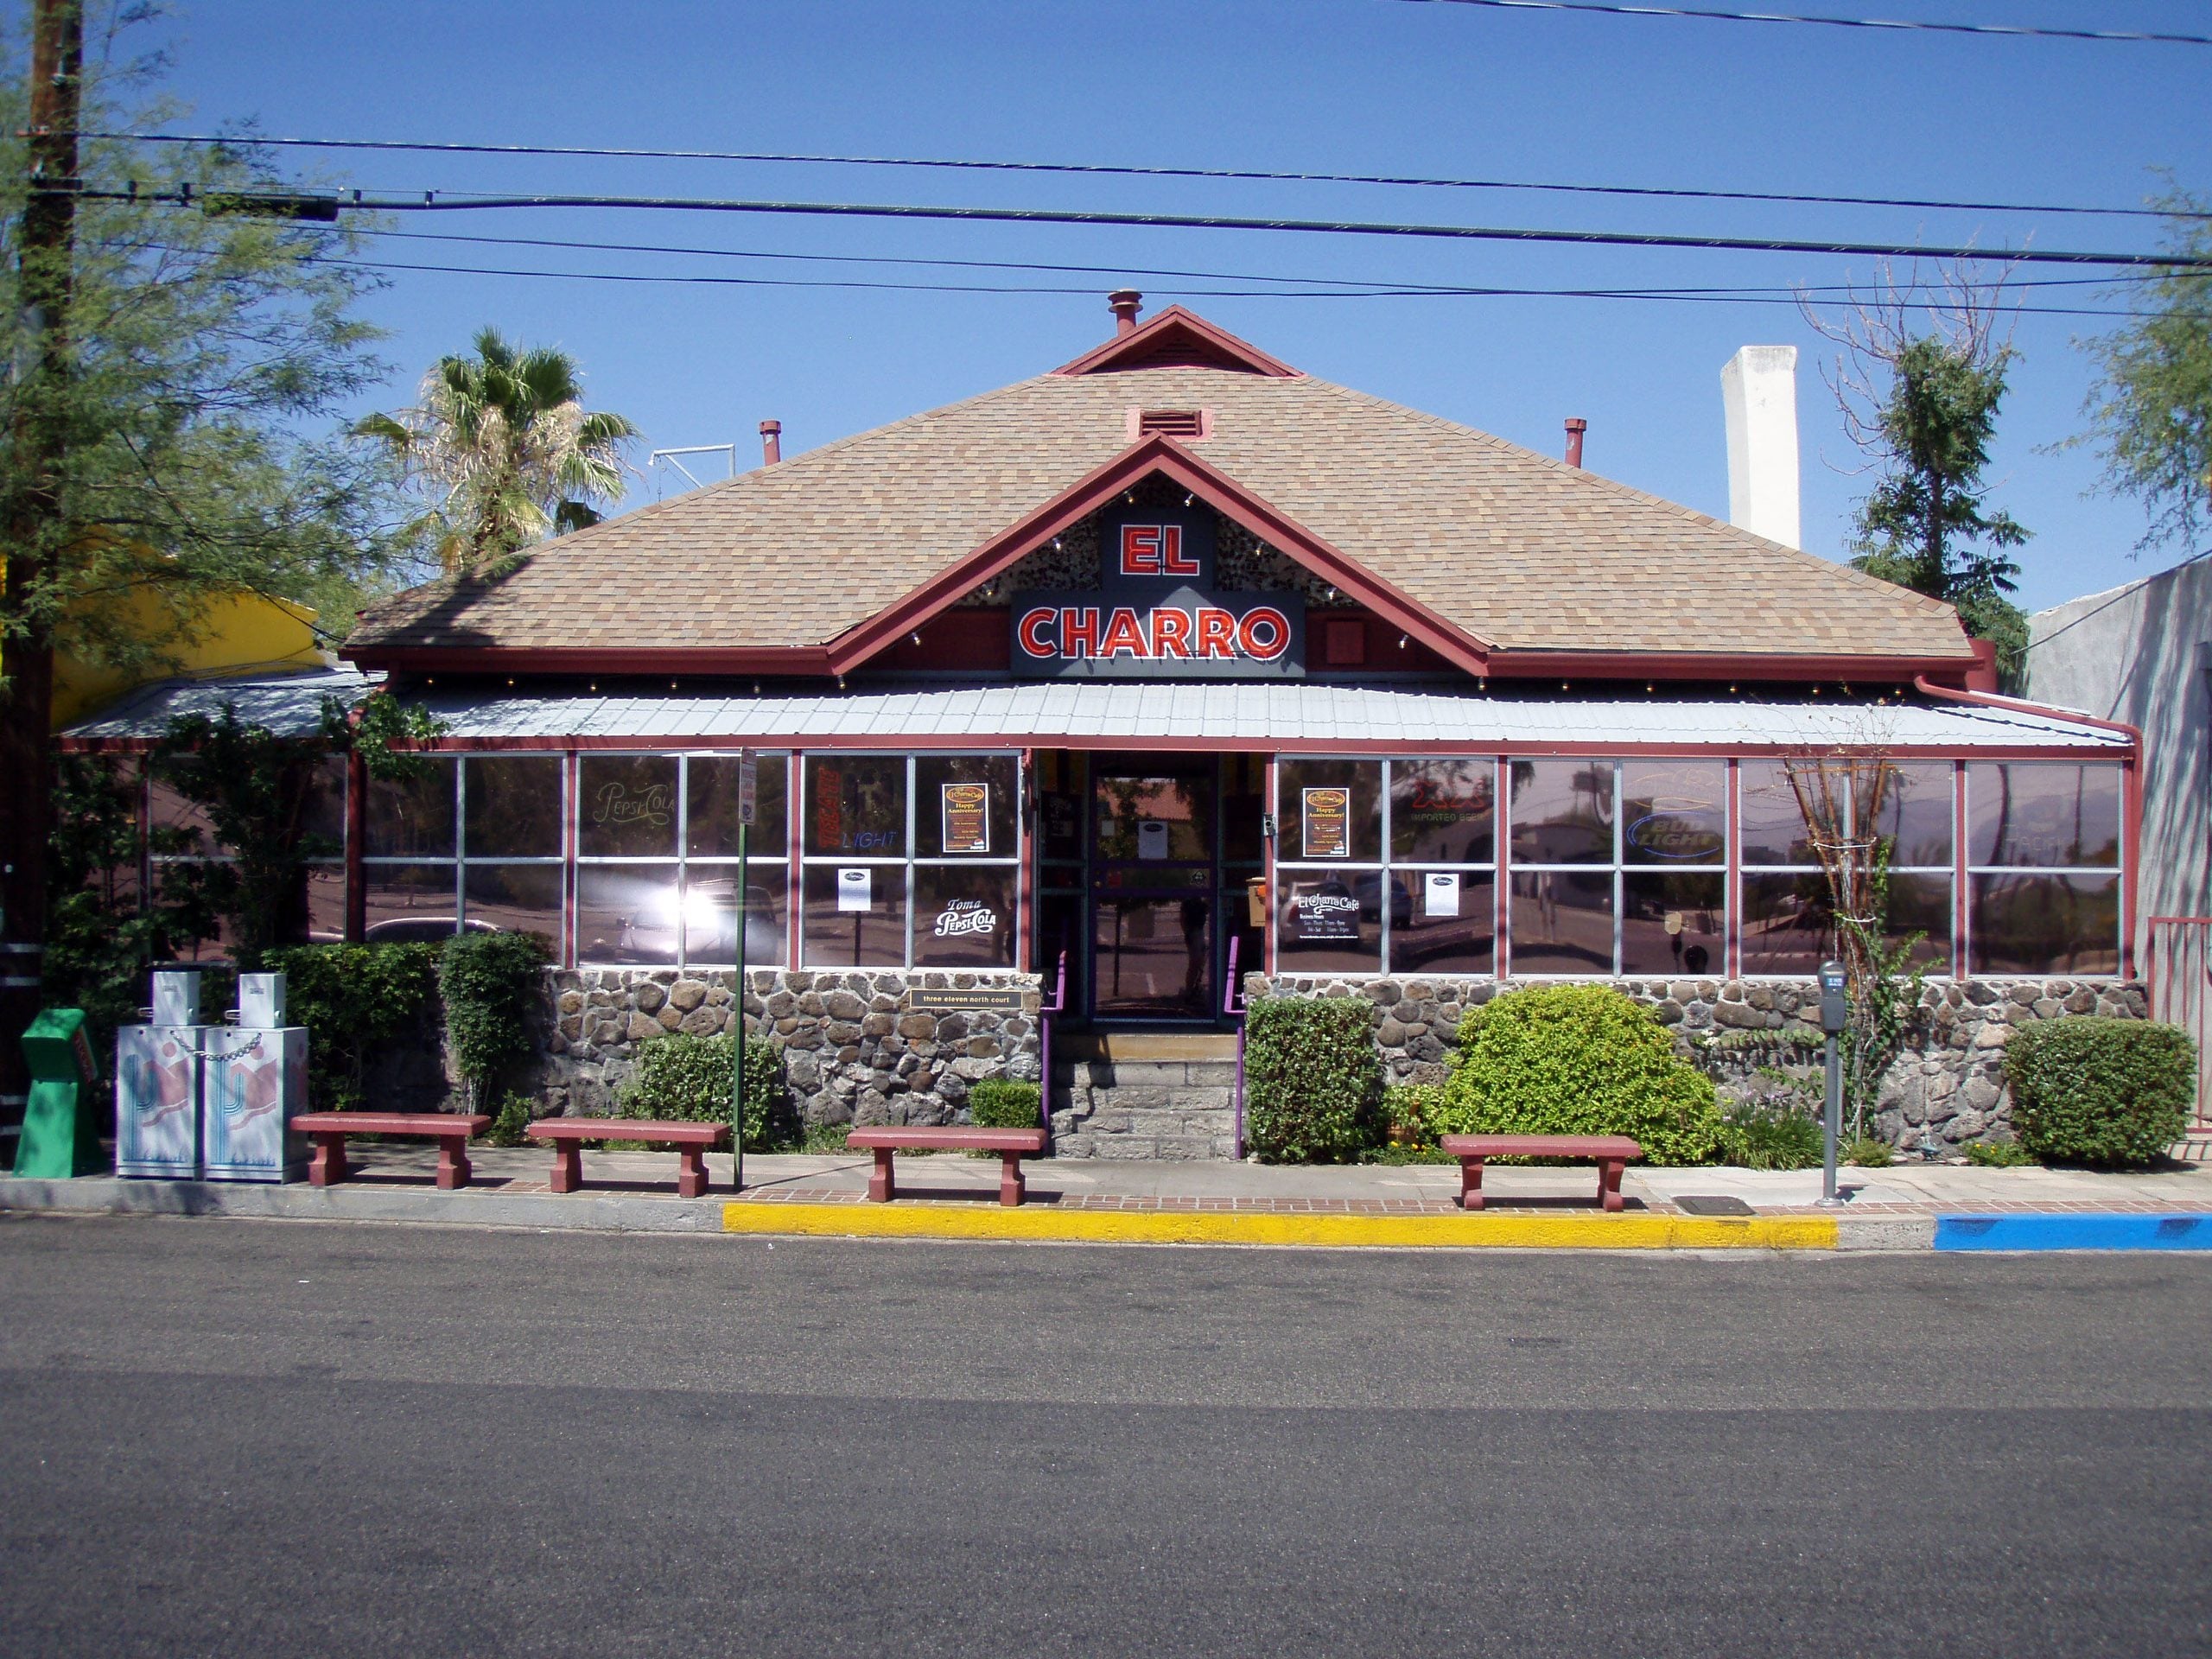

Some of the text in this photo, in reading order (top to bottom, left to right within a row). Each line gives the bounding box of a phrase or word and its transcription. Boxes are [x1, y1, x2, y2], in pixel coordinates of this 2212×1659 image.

[1120, 524, 1200, 576] EL
[1018, 606, 1291, 661] CHARRO
[1410, 813, 1456, 823] IMPORTED
[1649, 819, 1706, 832] BUD
[842, 831, 897, 849] LIGHT
[1638, 833, 1716, 846] LIGHT
[947, 898, 982, 911] Toma
[1298, 896, 1308, 908] El
